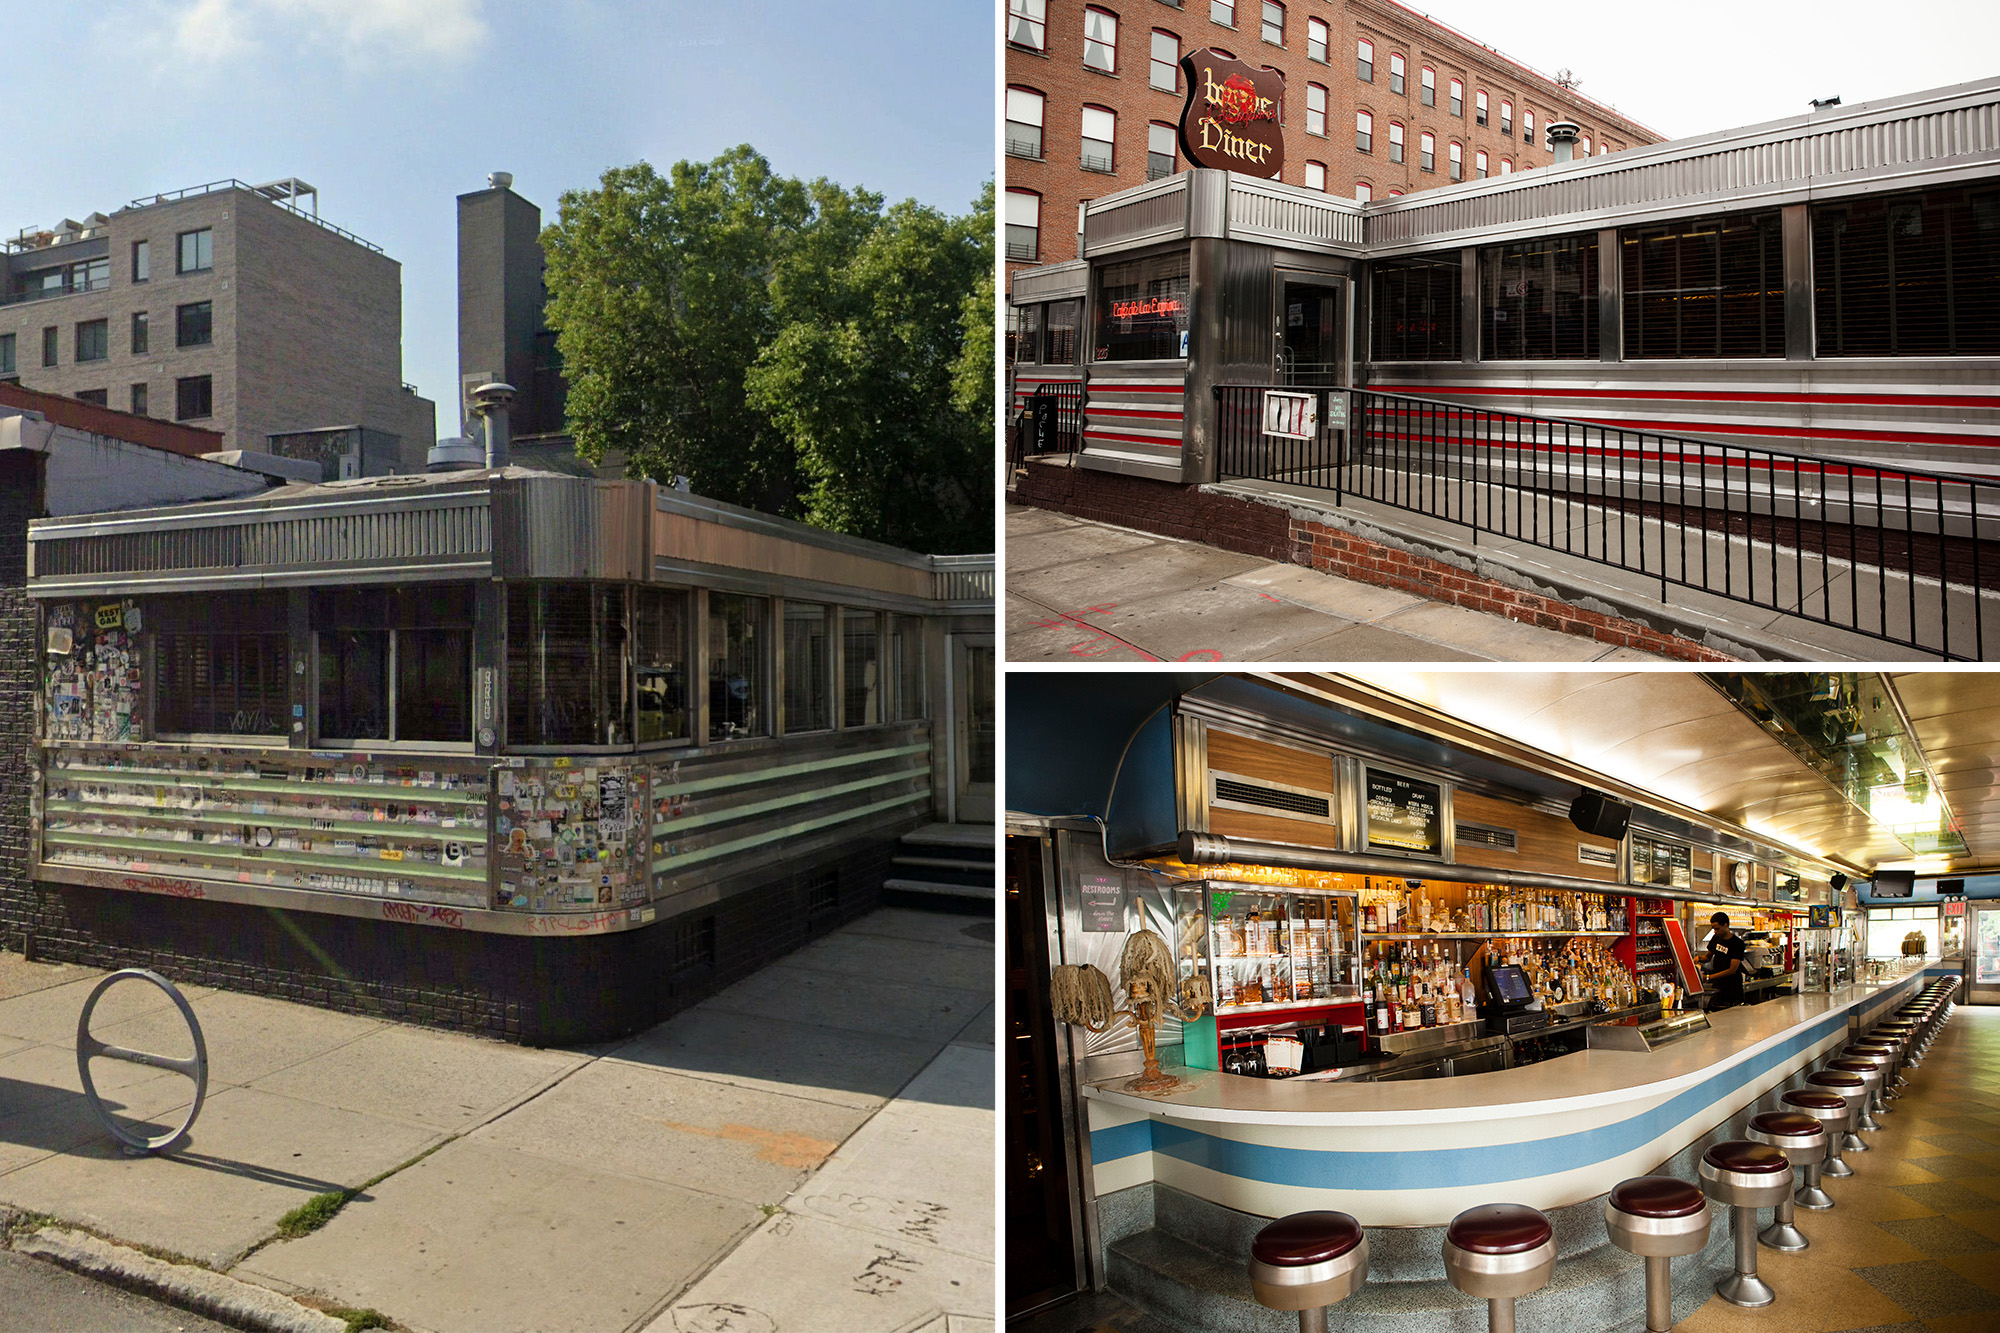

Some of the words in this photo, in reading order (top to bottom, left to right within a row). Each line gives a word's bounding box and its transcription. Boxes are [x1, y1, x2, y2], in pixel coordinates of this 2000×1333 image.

[1198, 117, 1273, 165] Diner
[1372, 784, 1392, 793] BOTTLED
[1082, 884, 1120, 894] RESTROOMS
[1946, 903, 1965, 915] EXIT
